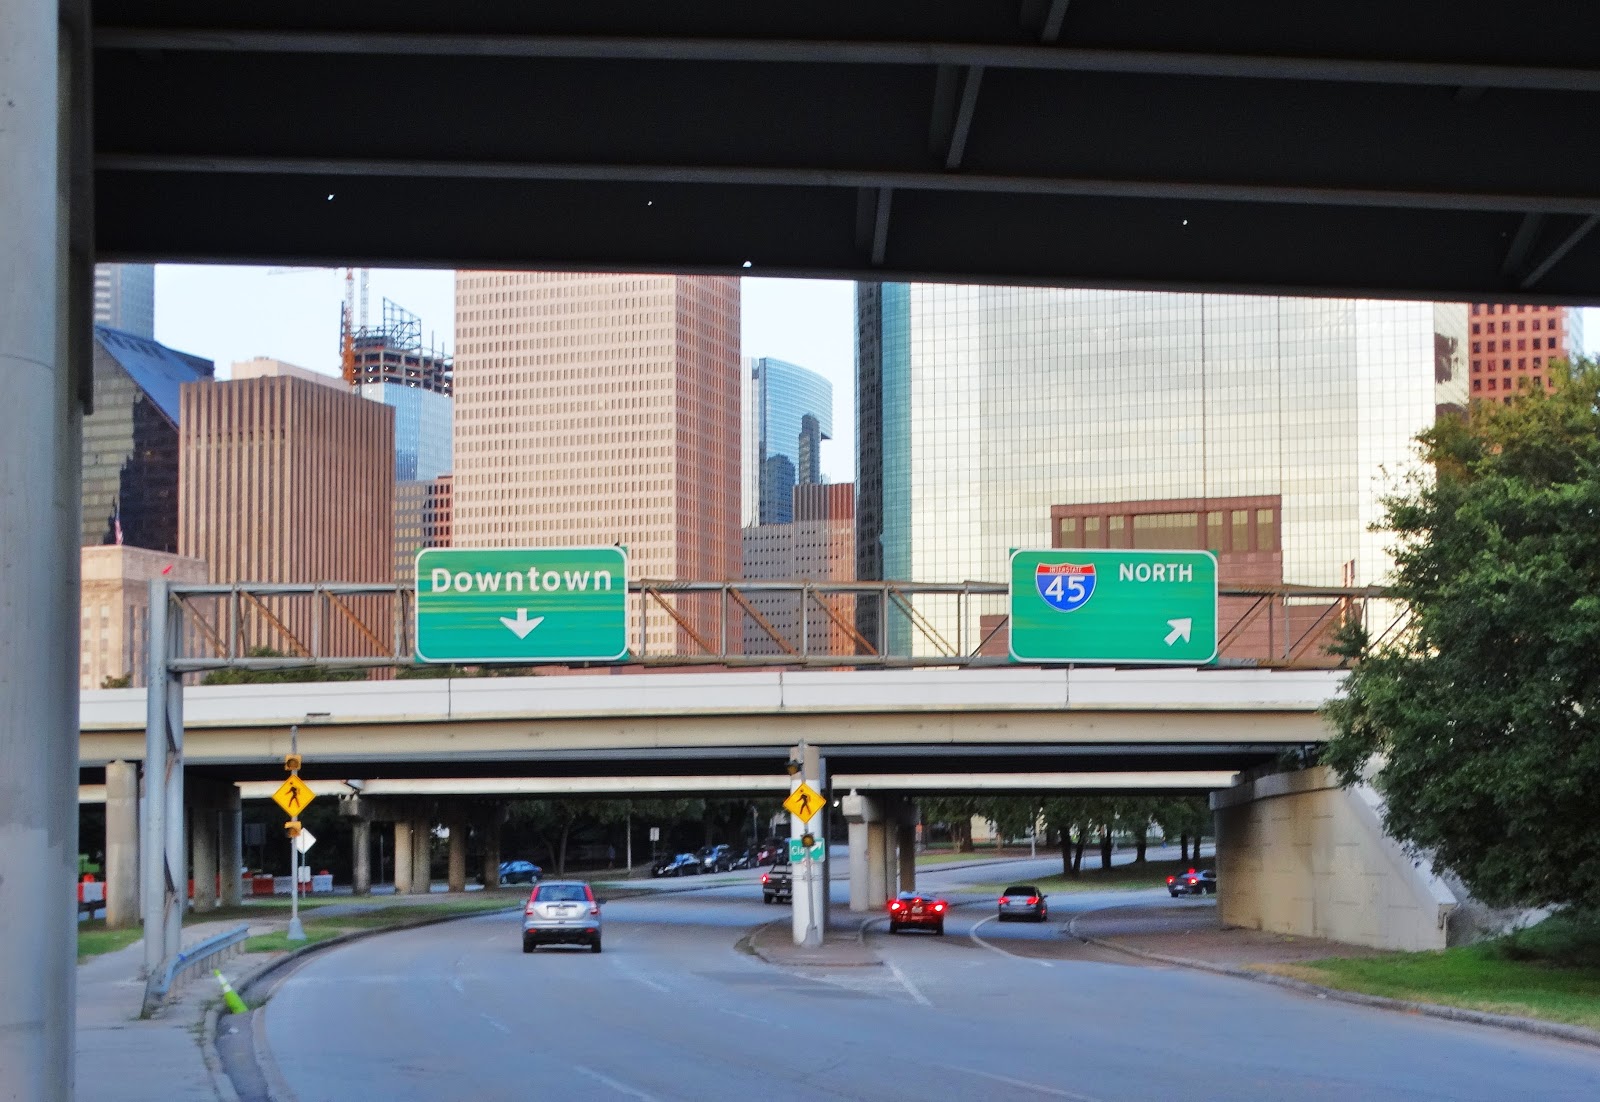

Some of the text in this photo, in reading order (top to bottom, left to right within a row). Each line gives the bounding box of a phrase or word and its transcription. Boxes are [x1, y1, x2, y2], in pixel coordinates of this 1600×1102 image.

[431, 566, 612, 593] Downtown
[1119, 563, 1193, 583] NORTH
[1044, 575, 1086, 603] 45
[791, 845, 807, 856] Cla
